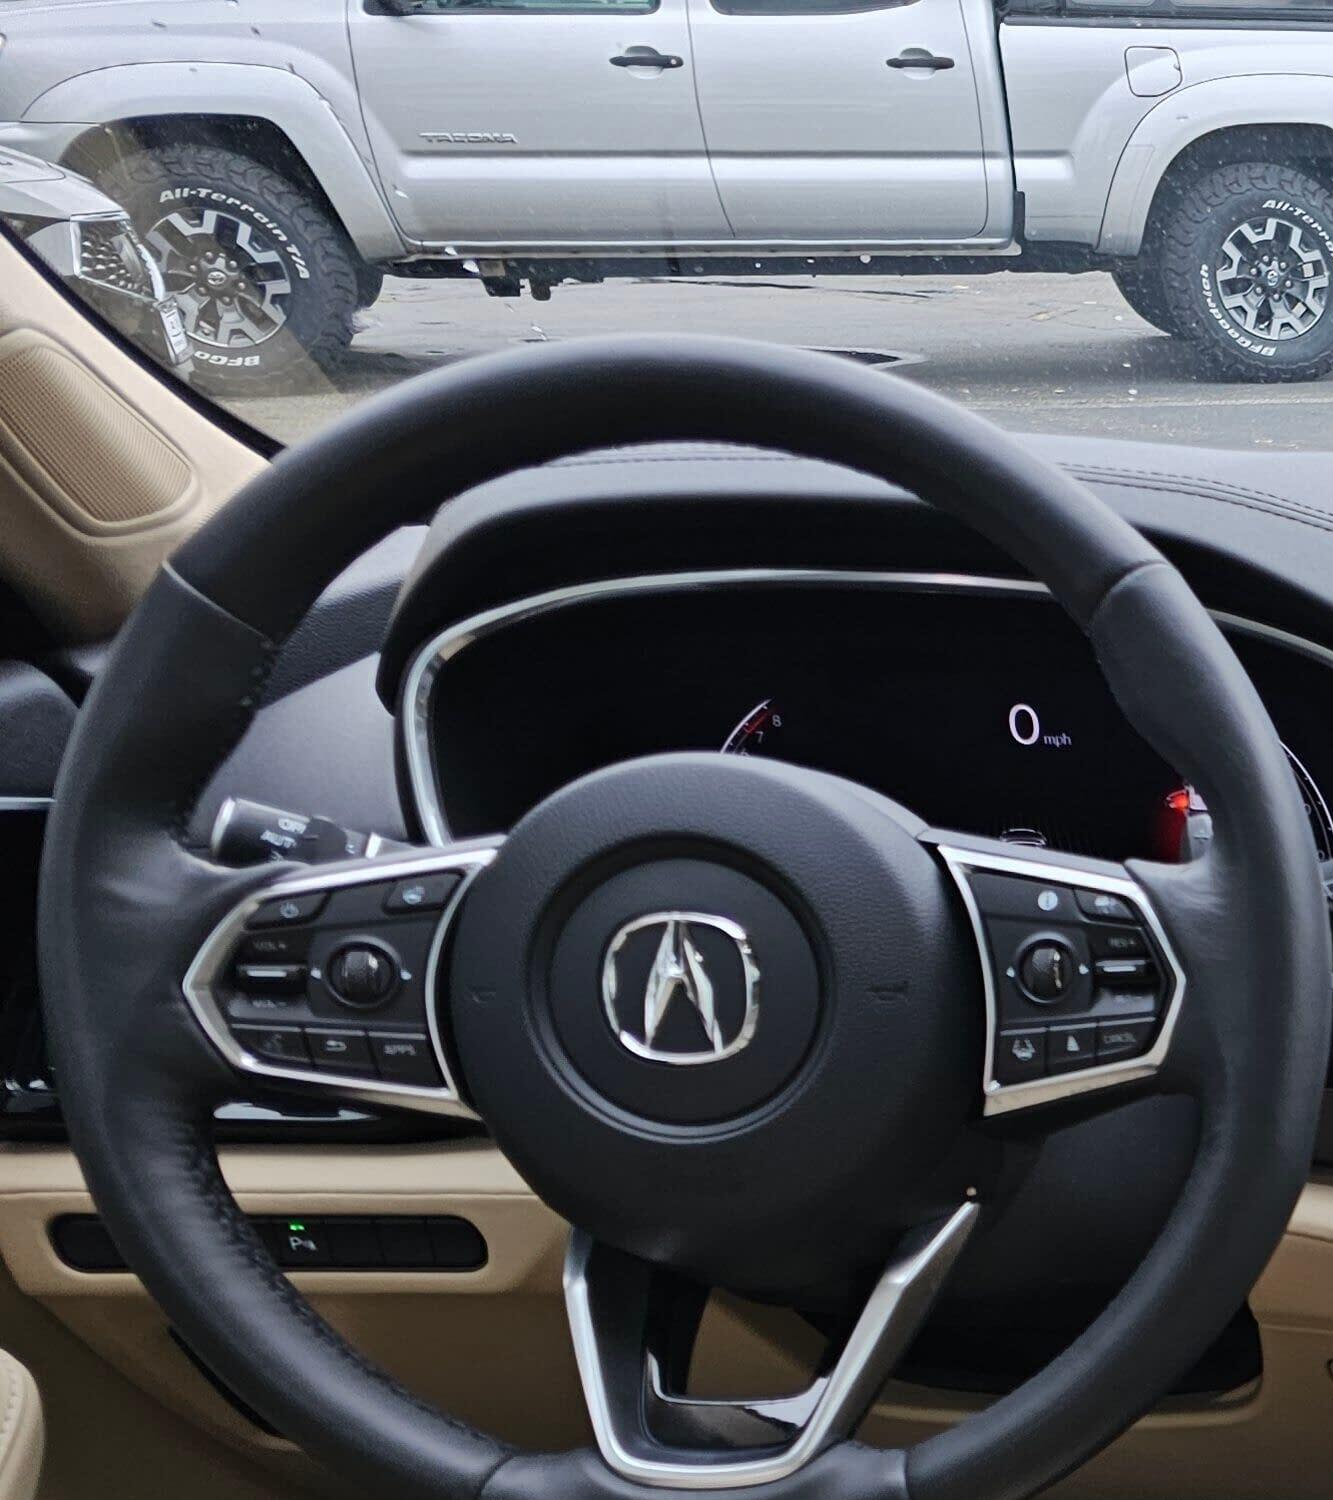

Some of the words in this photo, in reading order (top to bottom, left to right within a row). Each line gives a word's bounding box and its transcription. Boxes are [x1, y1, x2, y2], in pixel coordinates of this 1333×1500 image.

[419, 132, 517, 144] TACOMA
[773, 715, 781, 726] 8
[1009, 704, 1039, 745] 0
[1044, 733, 1071, 747] mph
